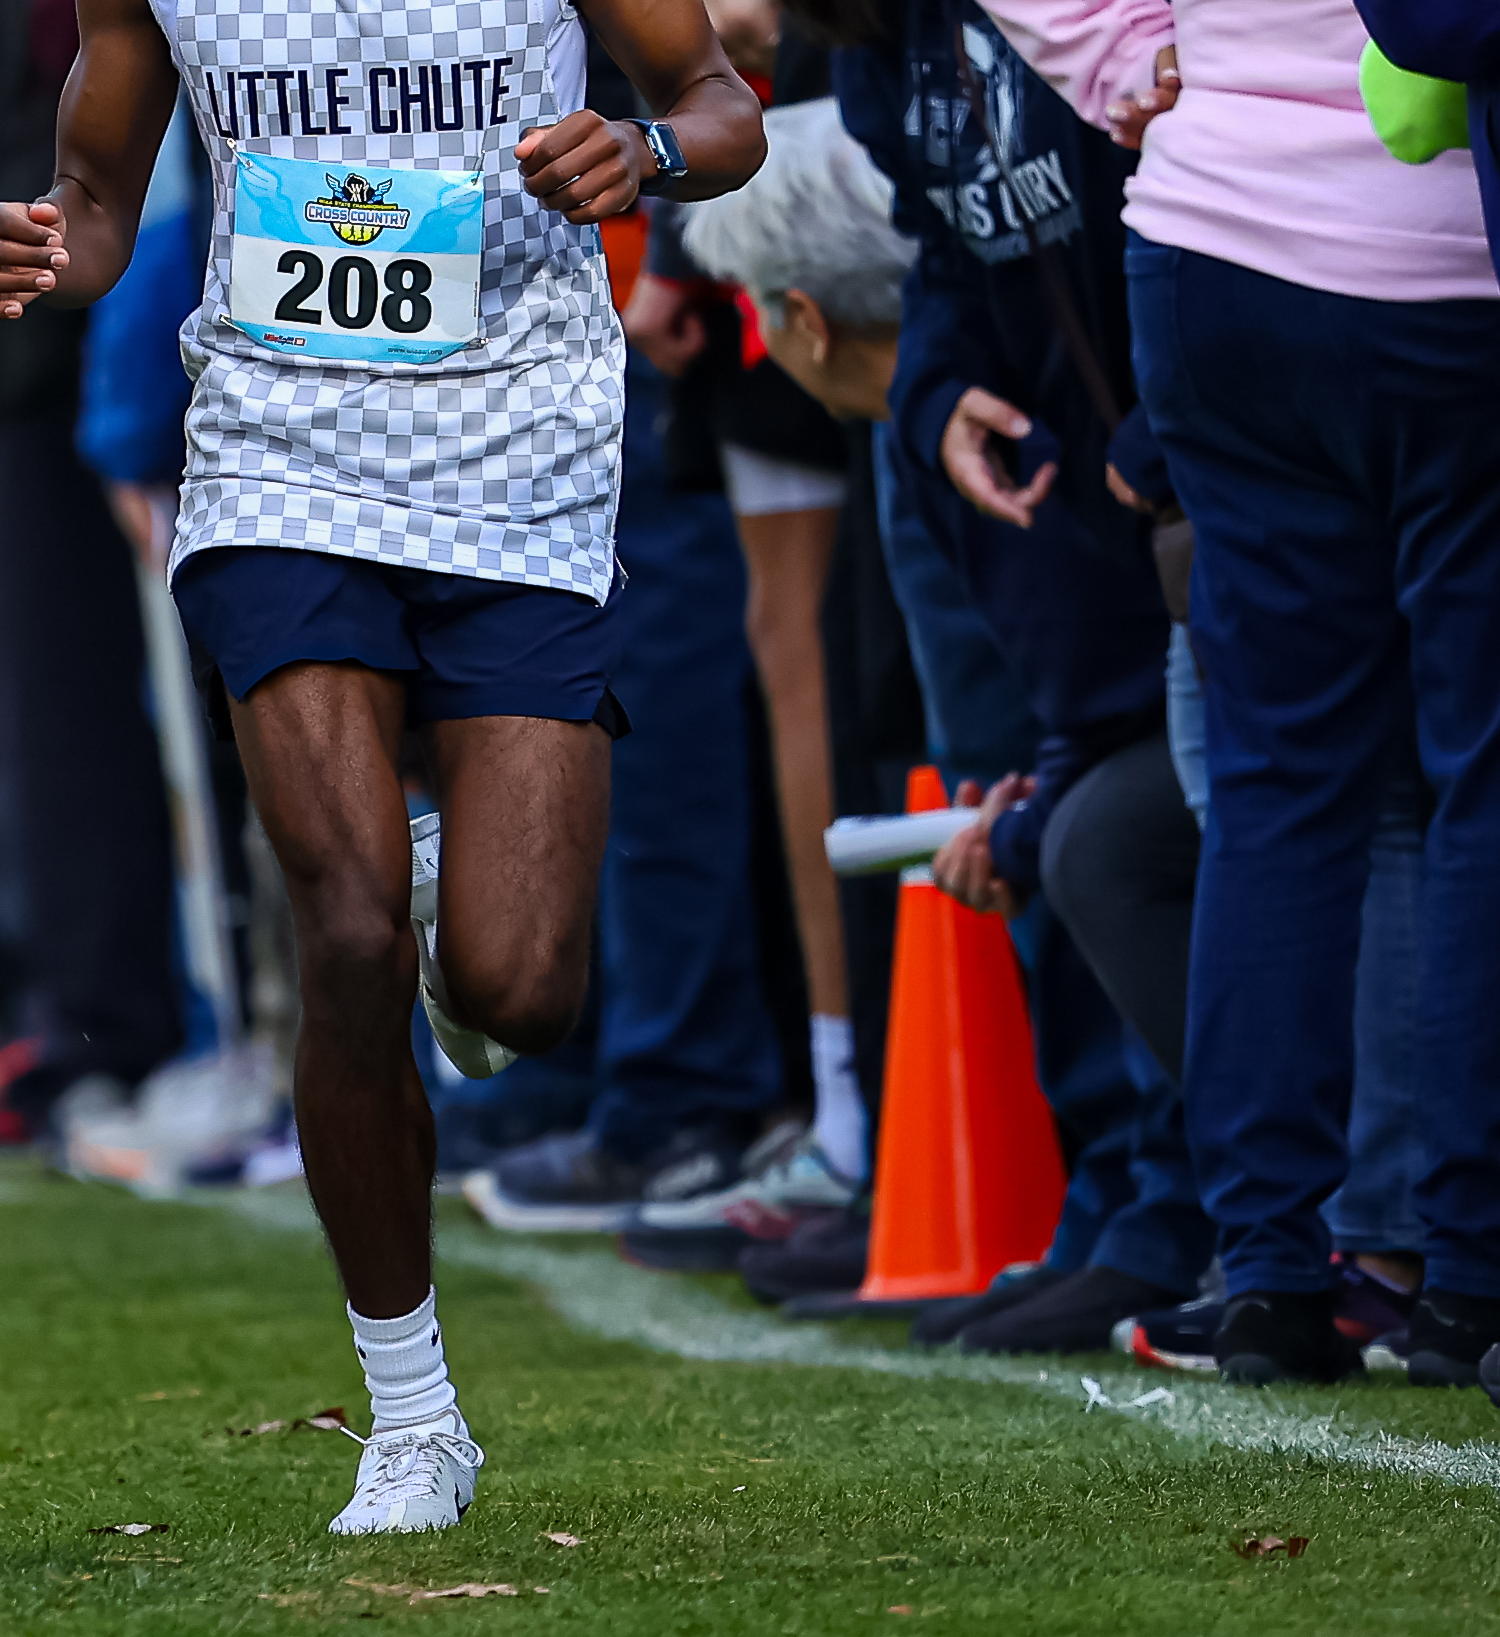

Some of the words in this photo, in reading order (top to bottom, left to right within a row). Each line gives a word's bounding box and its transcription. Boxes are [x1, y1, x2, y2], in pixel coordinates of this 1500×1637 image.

[206, 68, 352, 140] LITTLE
[369, 57, 514, 134] CHUTE
[308, 205, 348, 221] CROSS
[350, 210, 407, 226] COUNTRY
[274, 249, 433, 334] 208
